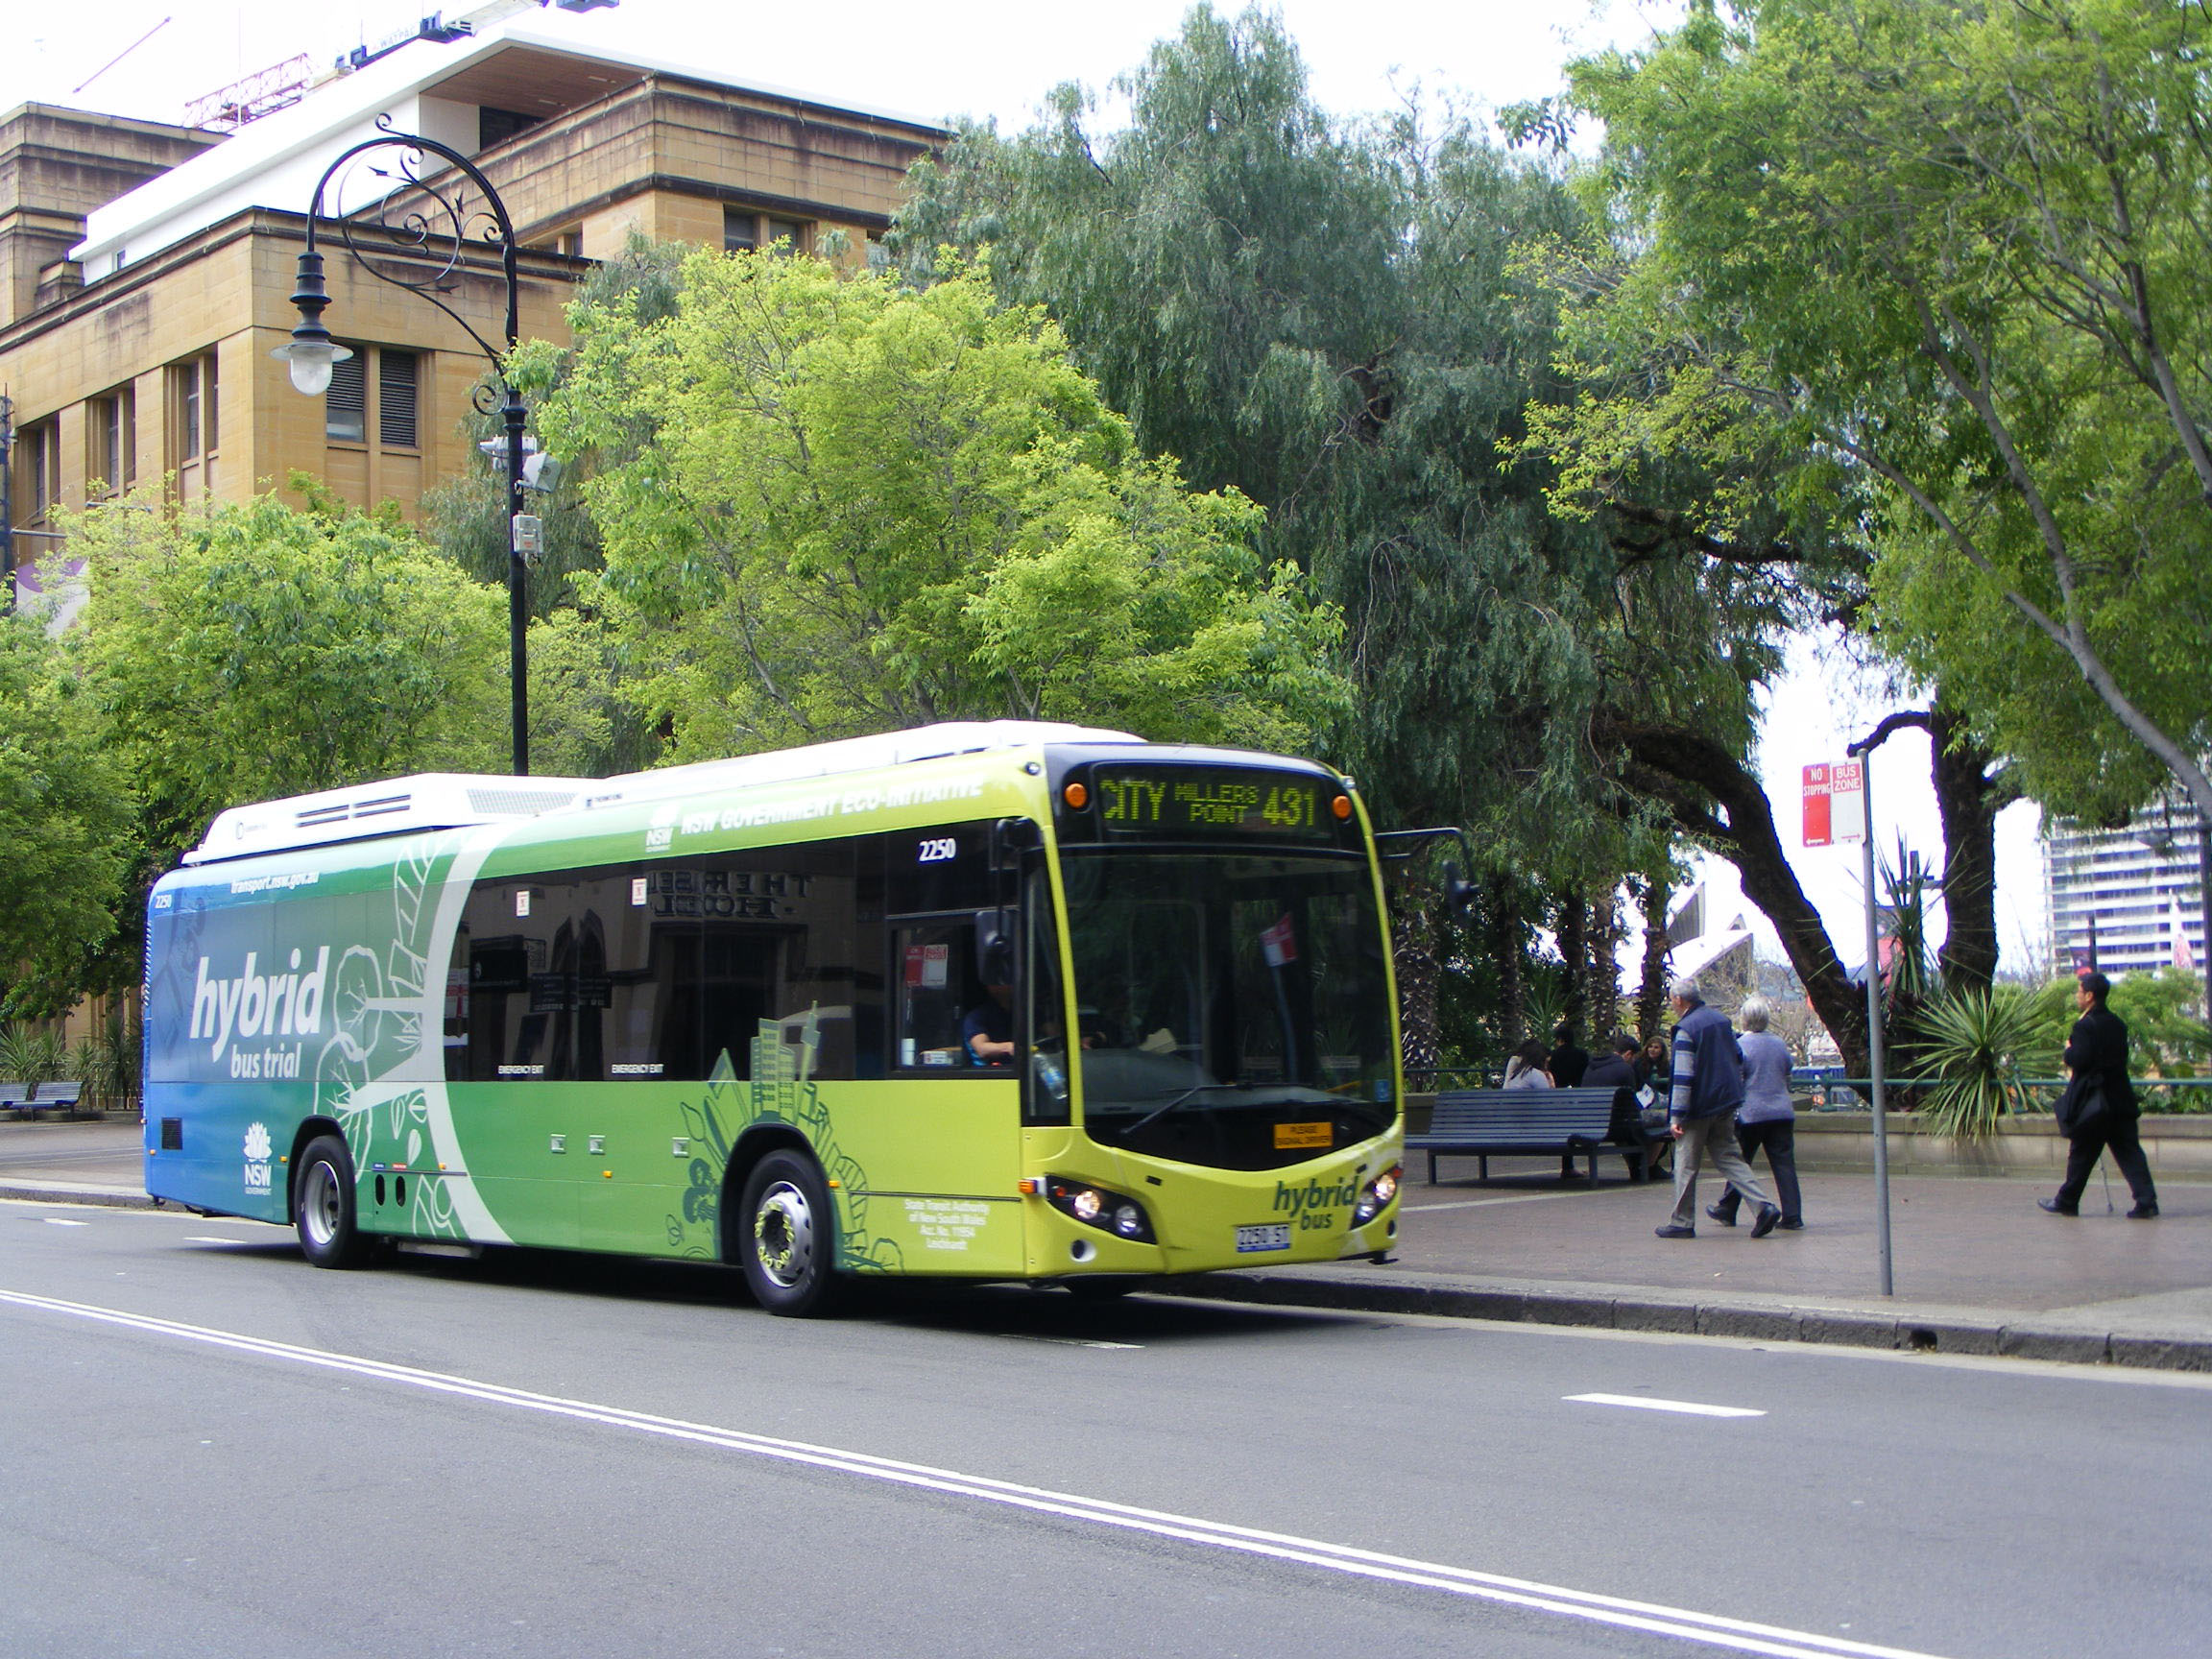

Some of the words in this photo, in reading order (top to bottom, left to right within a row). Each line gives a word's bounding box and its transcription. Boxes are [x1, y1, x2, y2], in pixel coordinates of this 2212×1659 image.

[1811, 768, 1822, 781] NO
[1837, 765, 1856, 779] BUS
[1174, 782, 1259, 804] MILLERS
[1804, 783, 1830, 797] STOPPING
[1834, 778, 1860, 792] ZONE
[681, 812, 721, 834] NSW
[721, 794, 842, 830] GOVERNMENT
[1190, 804, 1247, 823] POINT
[1262, 786, 1314, 826] 431
[646, 829, 673, 846] NSW
[919, 837, 956, 862] 2250
[231, 872, 320, 895] transport.nsw.gov.au
[155, 894, 173, 909] 2250
[189, 945, 330, 1063] hybrid
[230, 1044, 260, 1079] bus
[264, 1042, 302, 1078] trial
[498, 1065, 531, 1074] EMERGENCY
[612, 1064, 648, 1074] EMERGENCY
[245, 1164, 272, 1187] NSW
[1273, 1175, 1359, 1217] hybrid
[1301, 1209, 1333, 1230] bus
[1238, 1228, 1266, 1246] 2250
